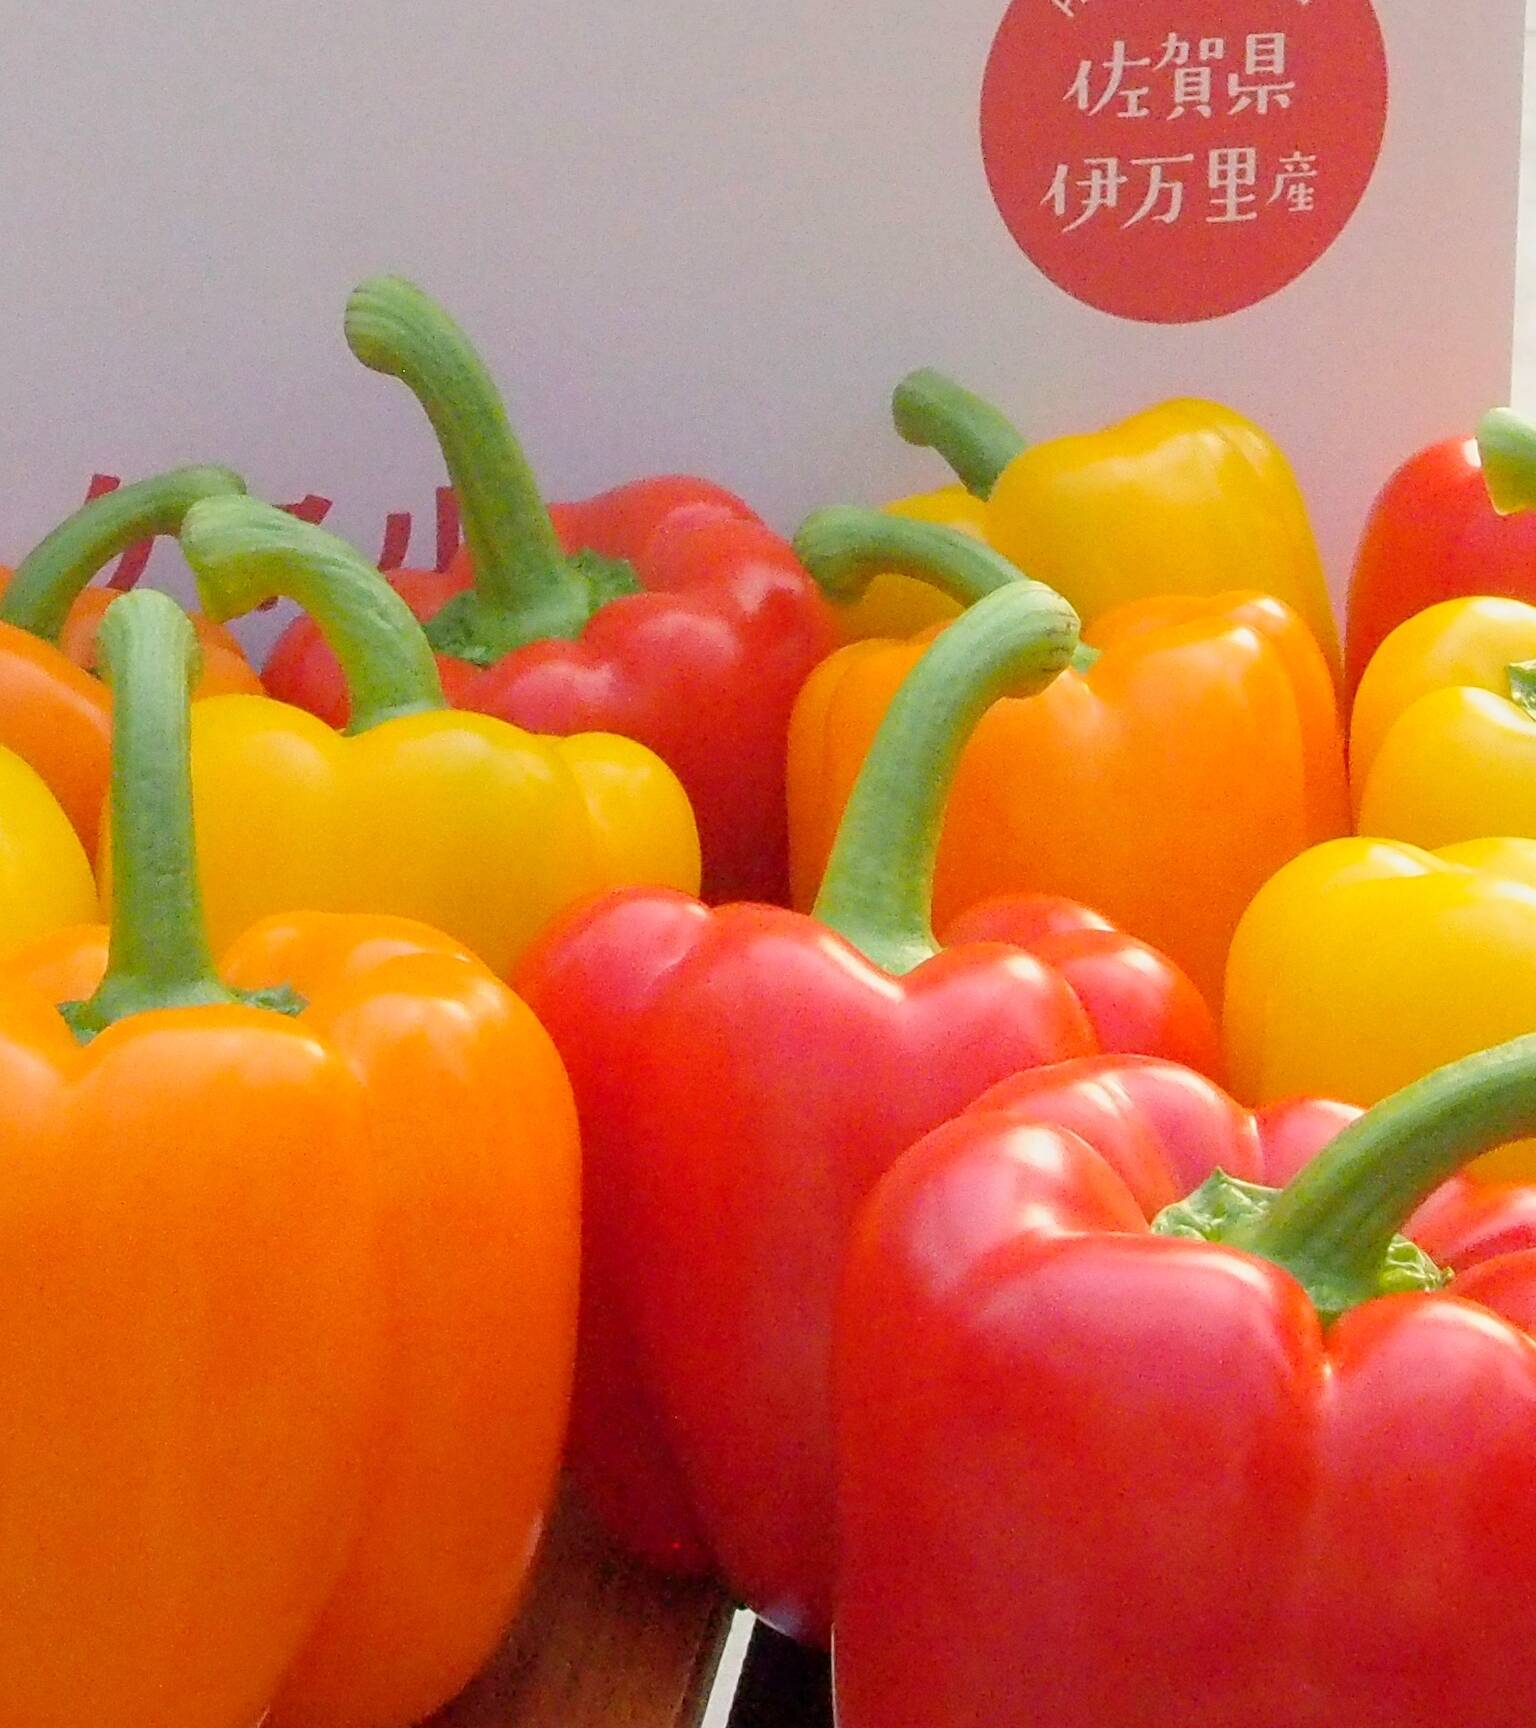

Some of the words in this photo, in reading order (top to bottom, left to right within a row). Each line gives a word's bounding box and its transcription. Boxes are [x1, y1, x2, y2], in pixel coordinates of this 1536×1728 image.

[1062, 31, 1296, 121] 佐賀県
[1040, 146, 1319, 234] 伊万里産
